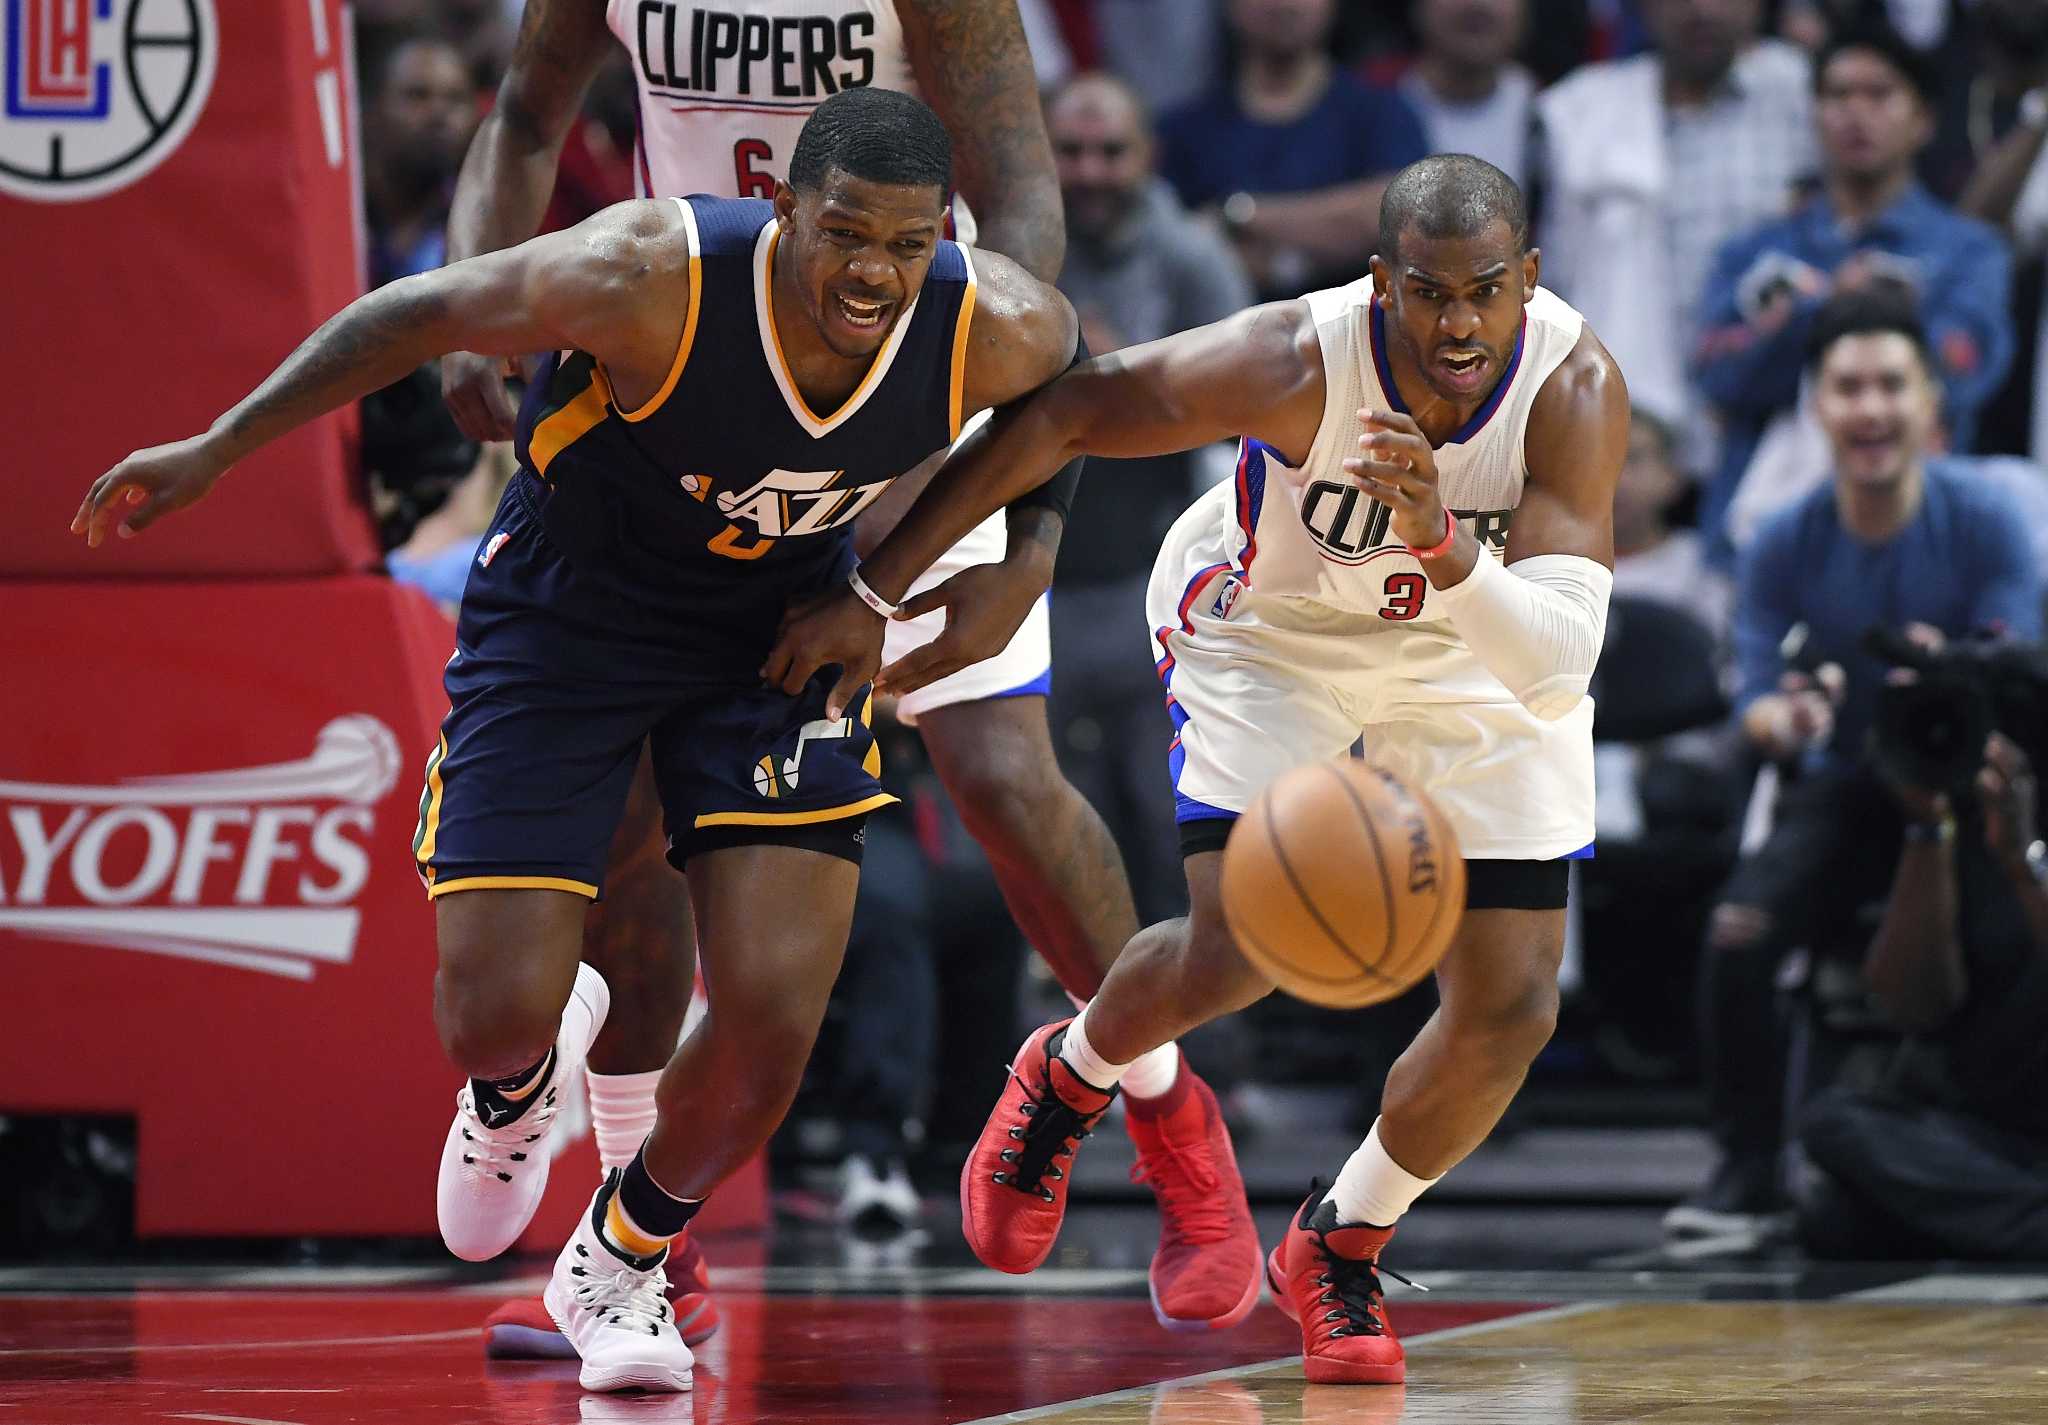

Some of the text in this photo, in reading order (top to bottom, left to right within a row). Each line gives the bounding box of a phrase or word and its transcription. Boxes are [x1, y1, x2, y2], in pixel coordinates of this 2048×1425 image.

[637, 0, 875, 97] CLIPPERS
[1379, 572, 1427, 622] 3
[0, 804, 374, 905] YOFFS
